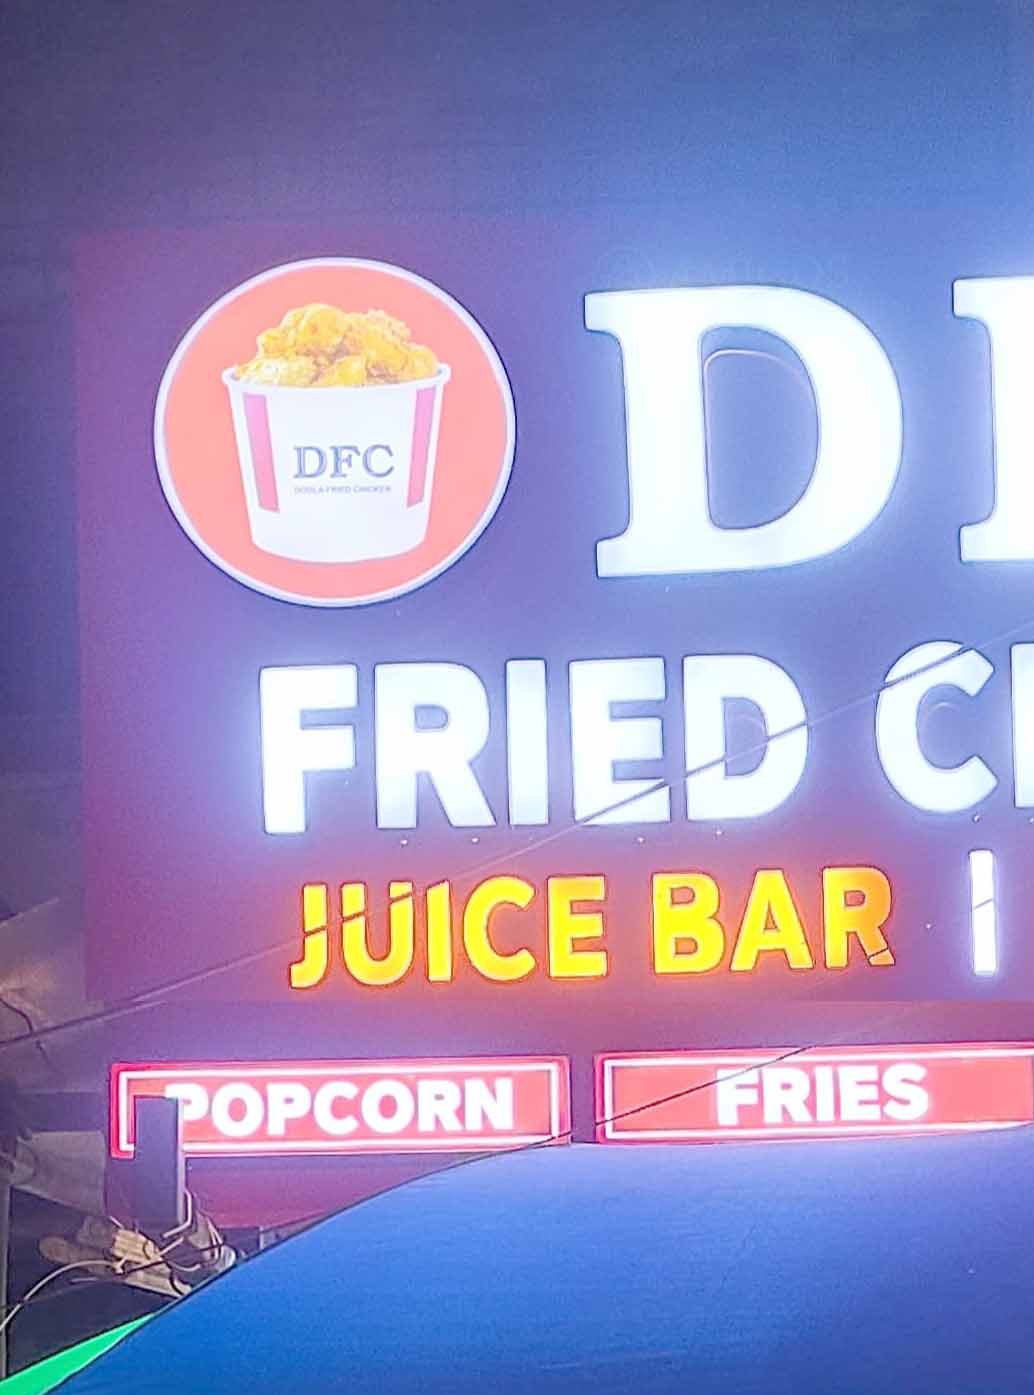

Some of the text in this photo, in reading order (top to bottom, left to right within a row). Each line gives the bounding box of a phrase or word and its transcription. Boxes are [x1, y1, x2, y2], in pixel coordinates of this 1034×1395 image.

[293, 444, 394, 478] DFC
[259, 655, 806, 834] FRIED
[290, 873, 607, 989] JUICE
[651, 866, 895, 975] BAR
[164, 1078, 513, 1137] POPCORN
[714, 1064, 928, 1126] FRIES
